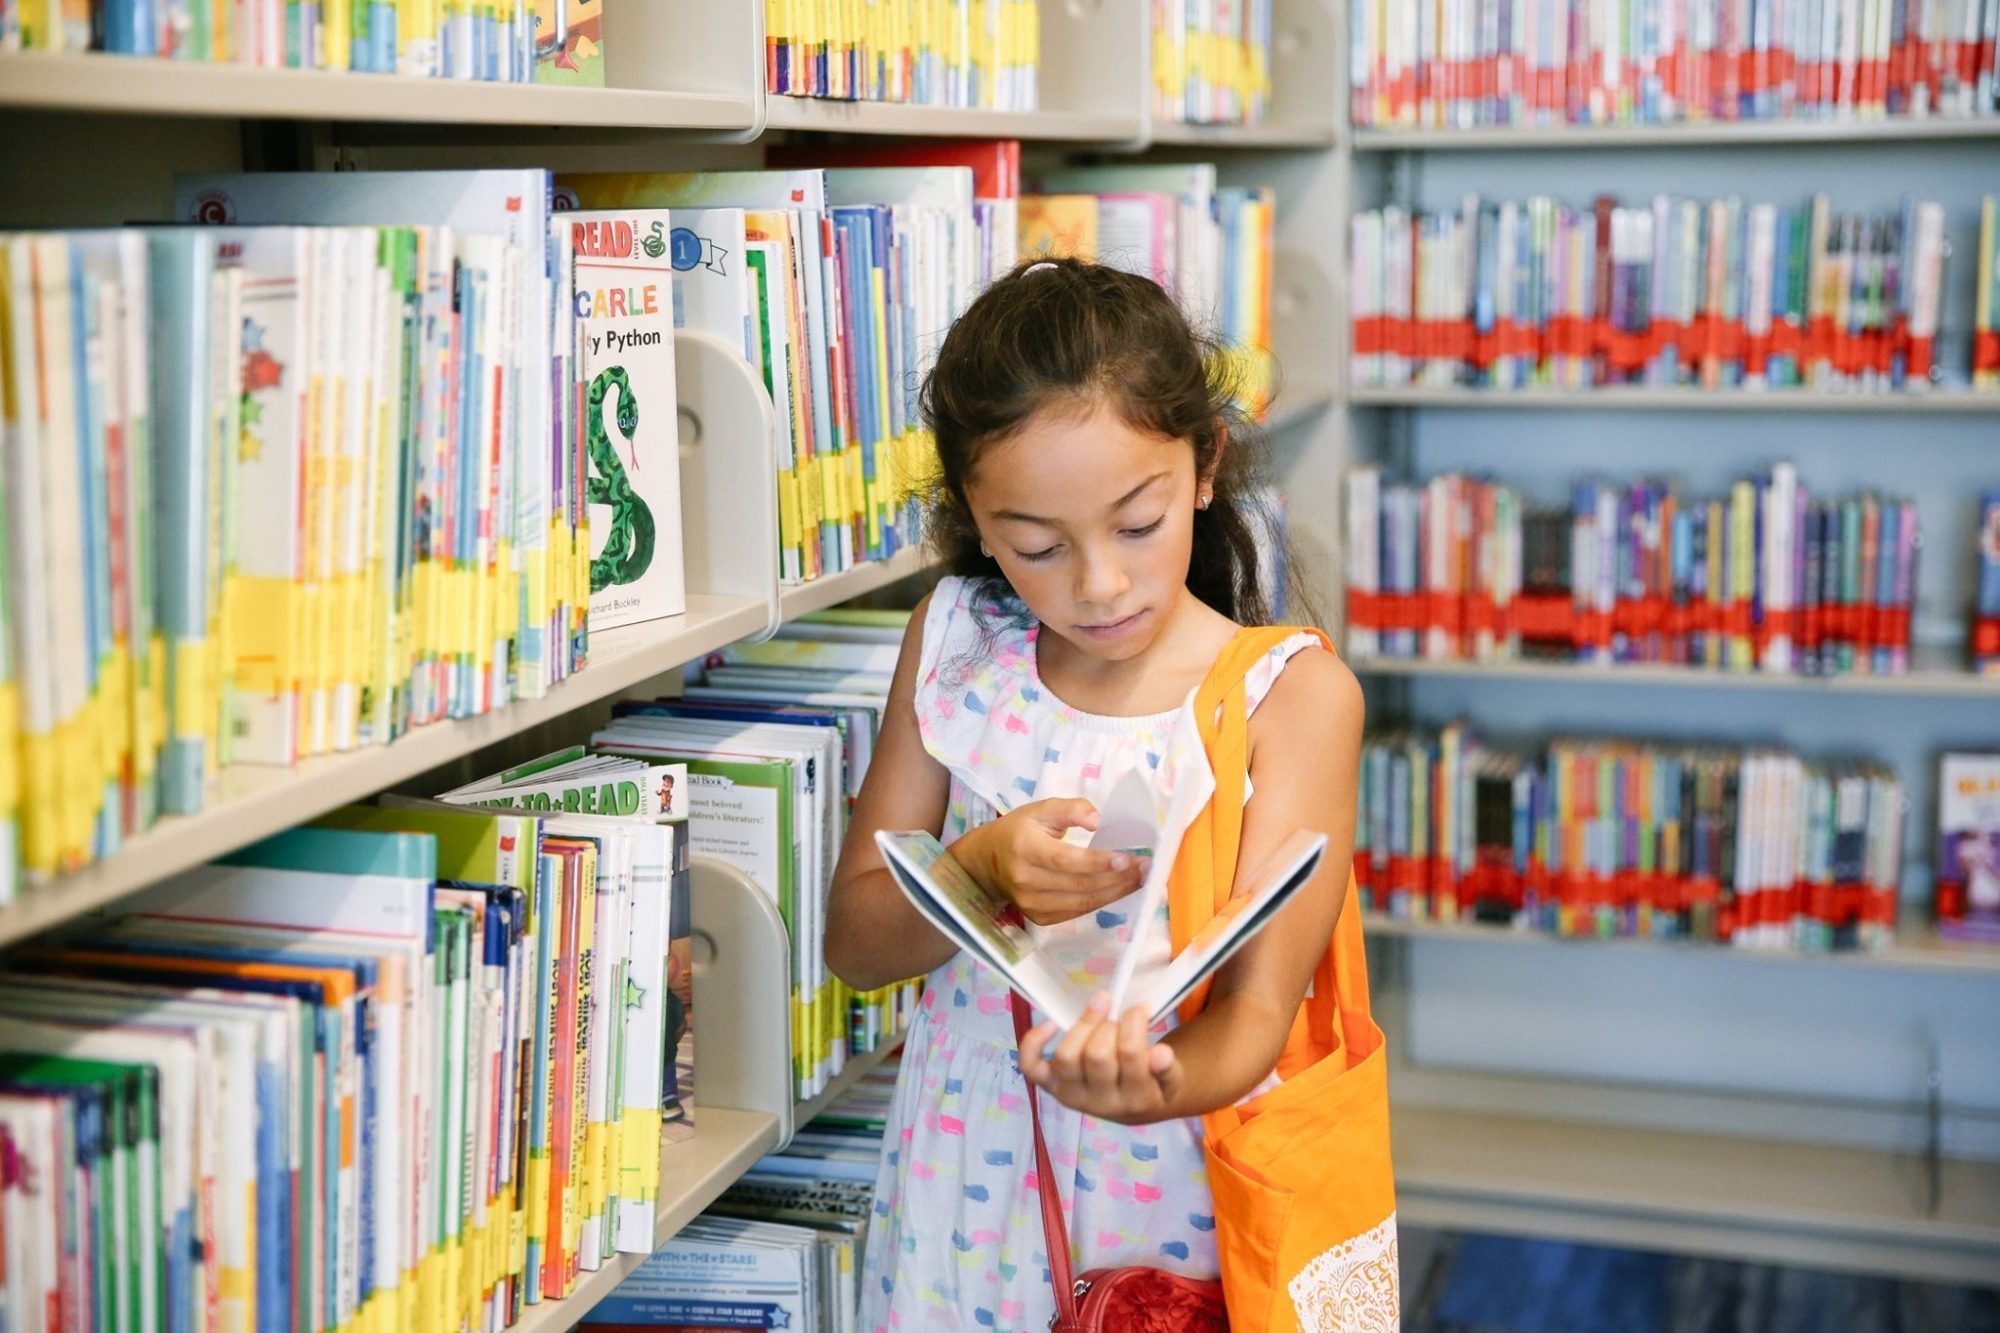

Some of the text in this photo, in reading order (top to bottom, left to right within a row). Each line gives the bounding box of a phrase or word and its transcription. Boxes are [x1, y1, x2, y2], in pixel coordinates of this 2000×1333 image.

[572, 221, 632, 258] READ
[677, 240, 688, 260] 1
[574, 285, 658, 319] CARLE
[607, 329, 661, 352] Python
[590, 597, 641, 614] ichard Buckley
[521, 791, 551, 812] TO
[563, 781, 639, 816] READ
[711, 799, 743, 809] beloved
[688, 811, 721, 820] ildren's
[653, 1252, 679, 1263] WITH
[689, 1253, 709, 1264] THE
